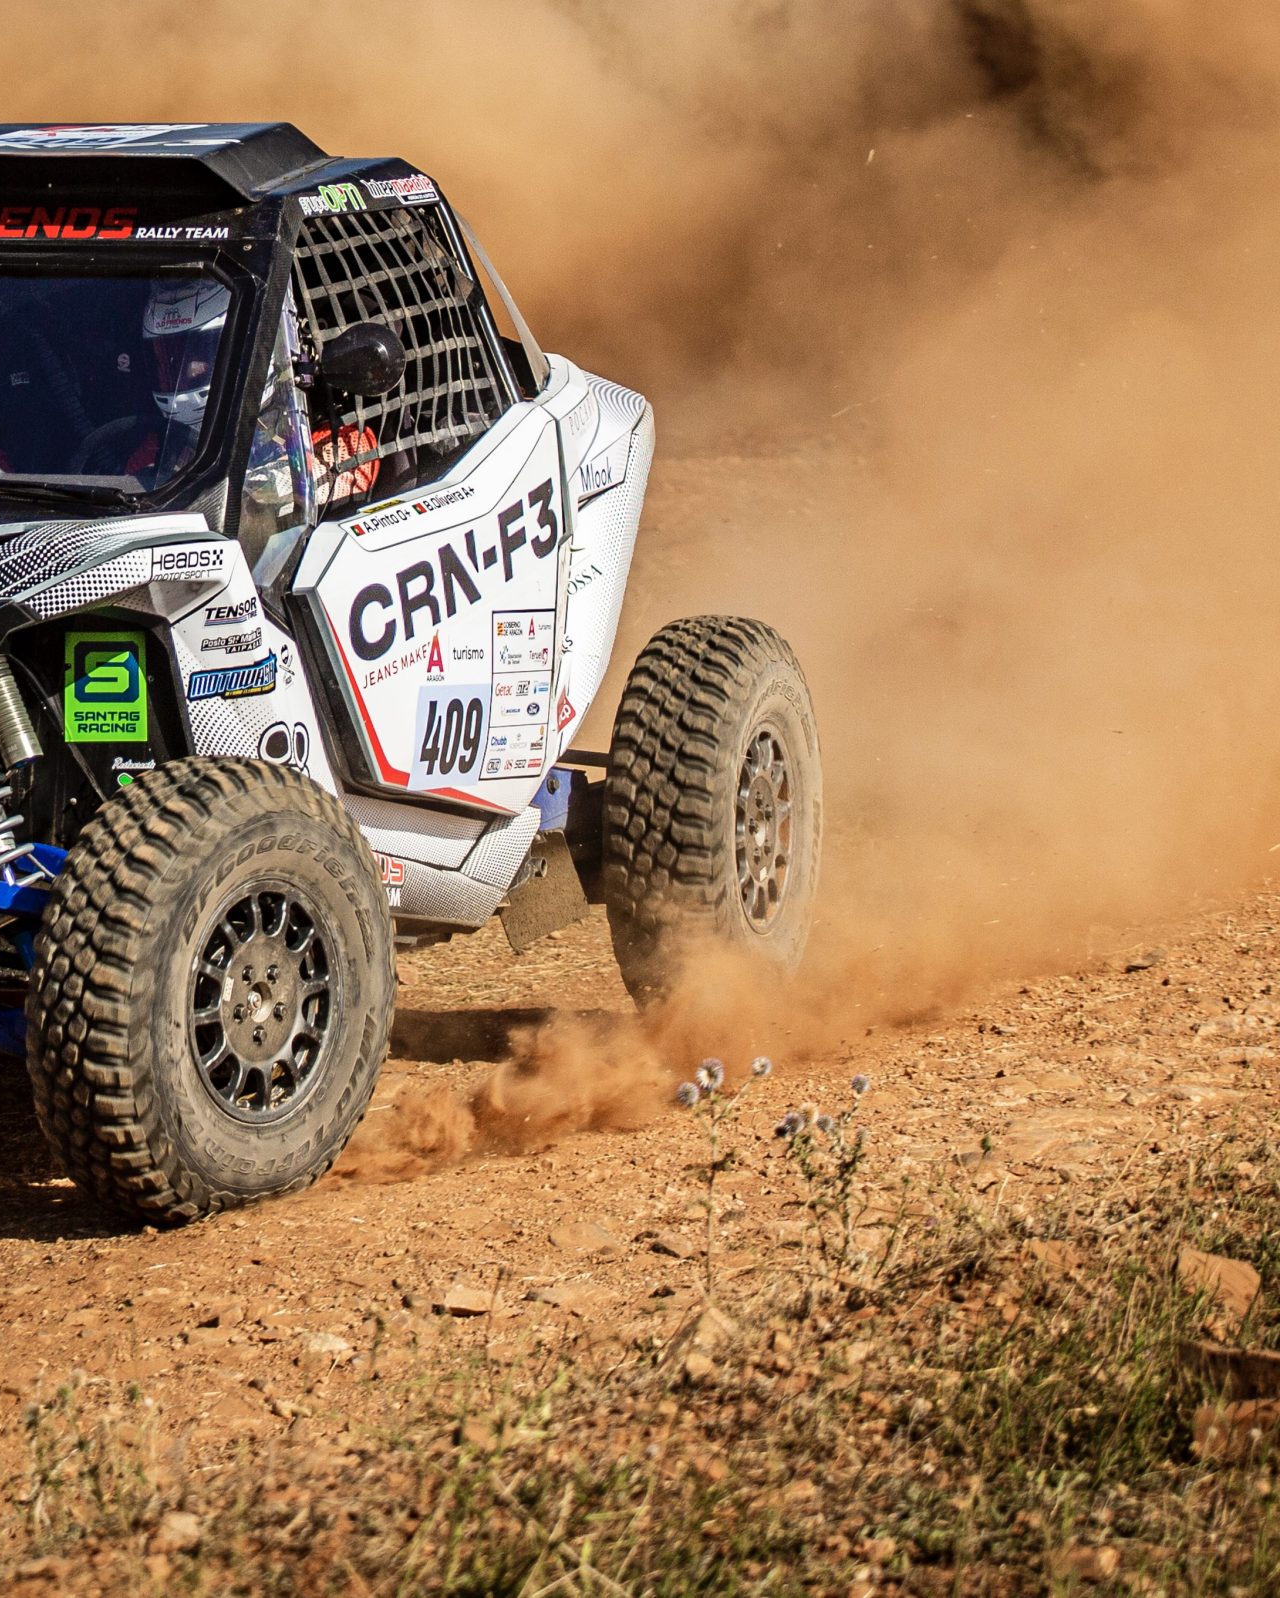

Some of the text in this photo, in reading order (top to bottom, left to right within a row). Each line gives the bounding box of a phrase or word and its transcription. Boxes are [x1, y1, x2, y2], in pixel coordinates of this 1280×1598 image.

[136, 227, 229, 240] RALLY TEAM
[580, 457, 612, 493] Mlook
[349, 478, 558, 661] CRN-F3
[205, 597, 257, 620] TENSOR
[453, 645, 484, 660] turismo
[363, 642, 430, 689] JEANS MAKE
[190, 660, 275, 697] MOTOWASH
[495, 683, 513, 696] Getac
[73, 711, 140, 722] SANTAG
[77, 723, 137, 734] RACING
[420, 697, 483, 775] 409
[491, 736, 507, 746] Chubb
